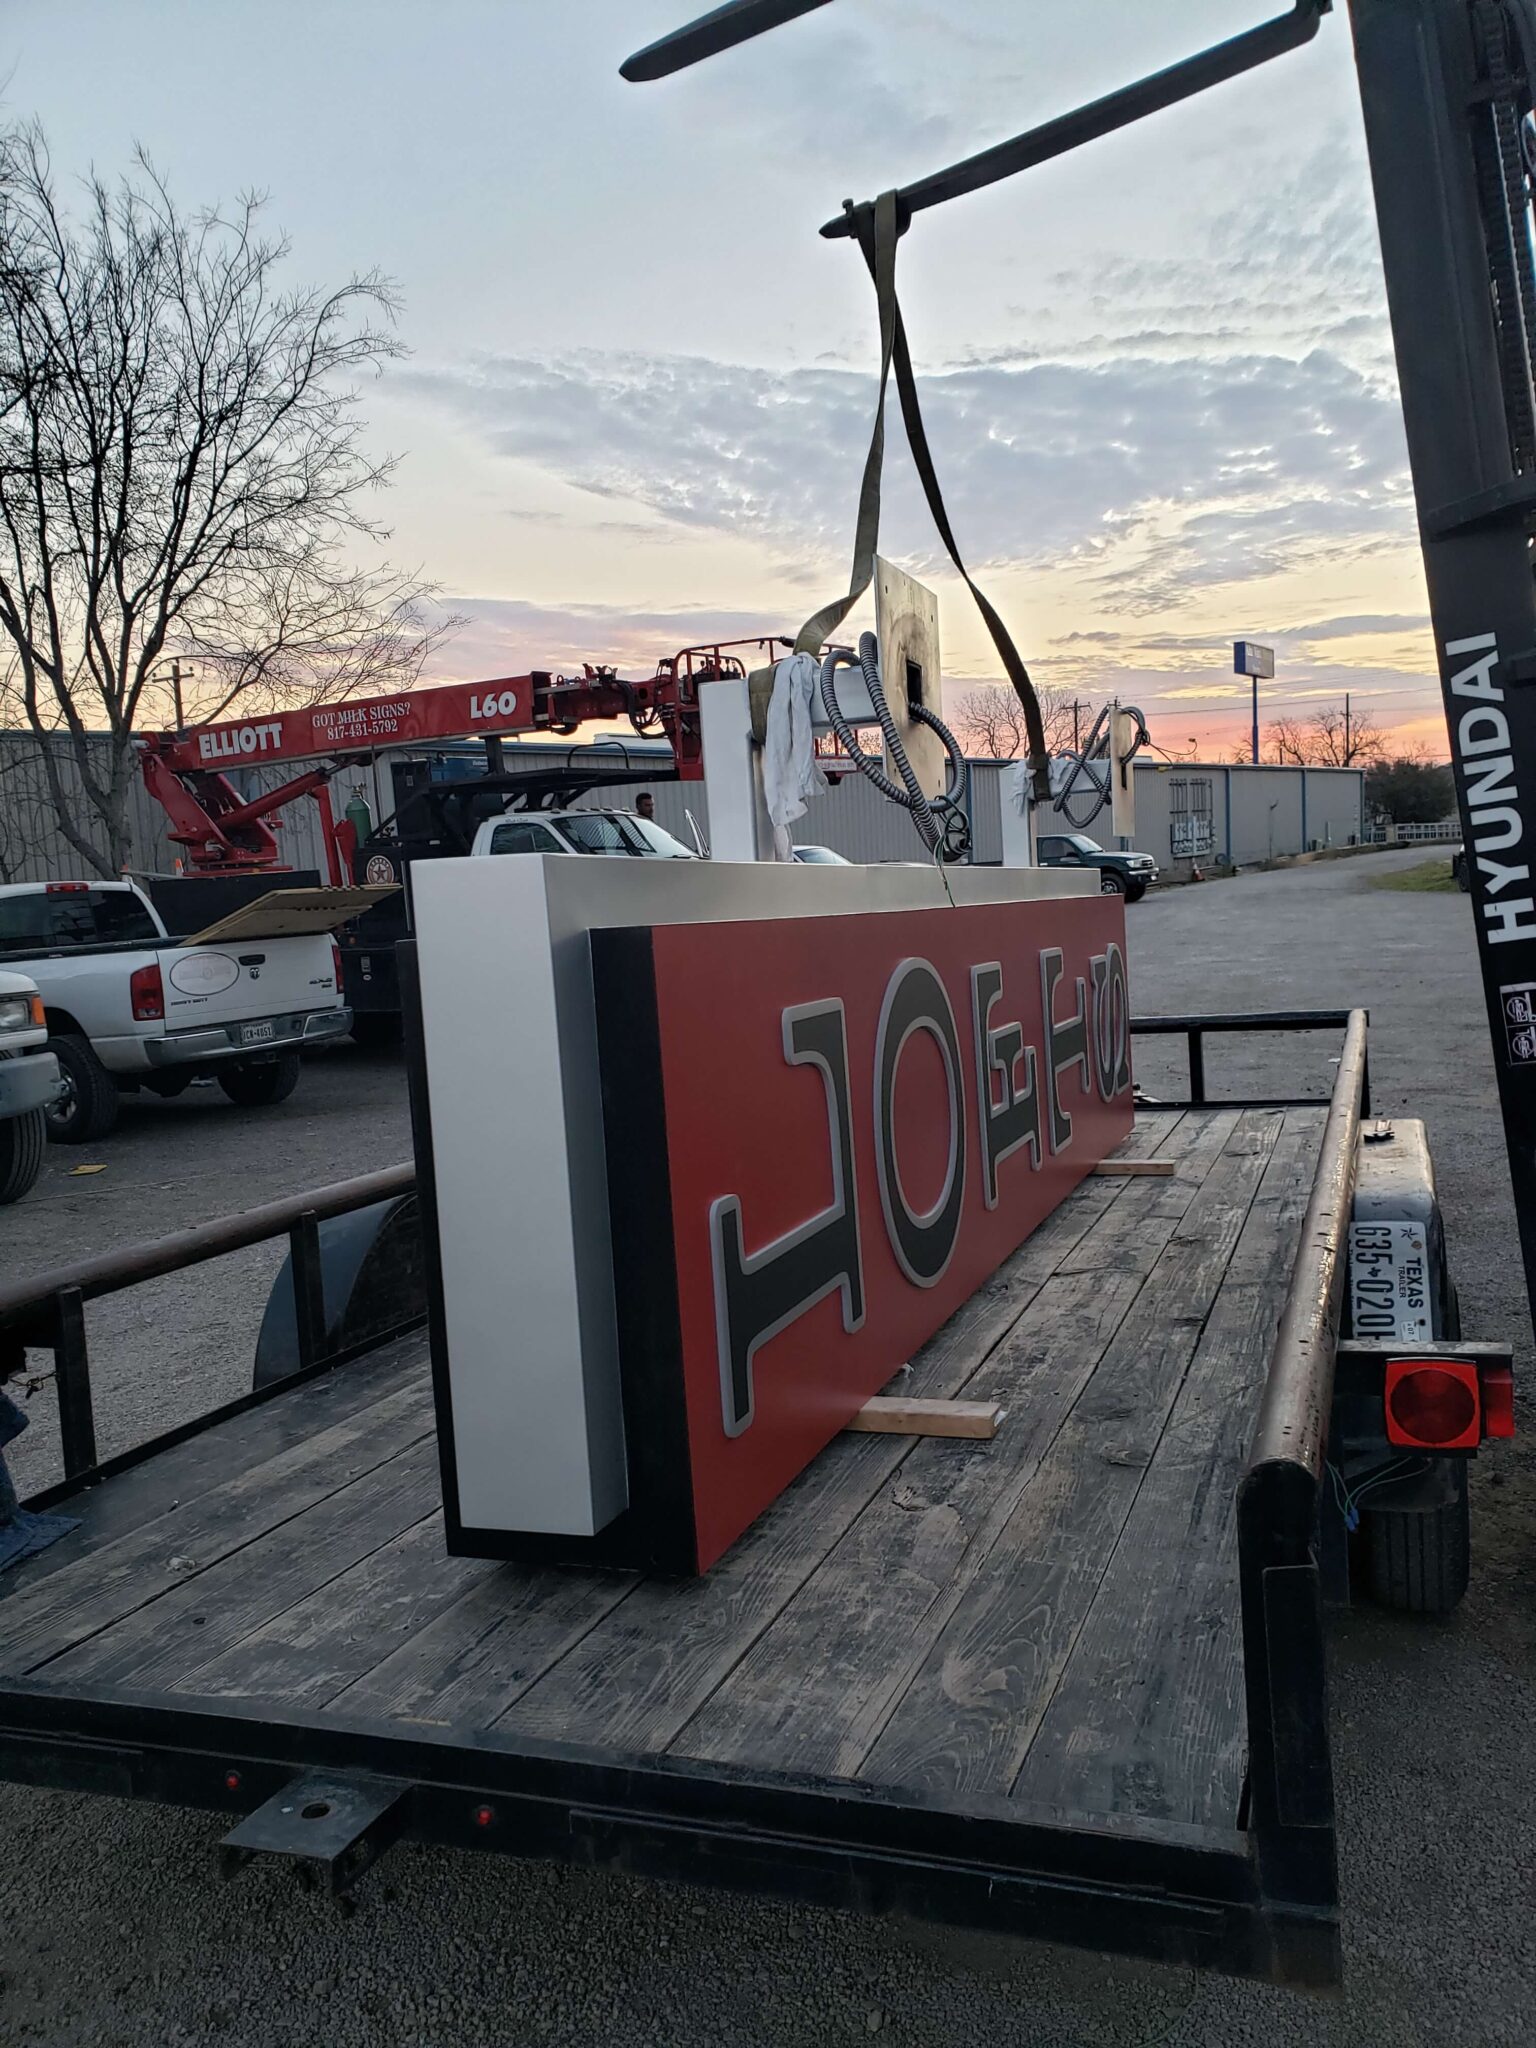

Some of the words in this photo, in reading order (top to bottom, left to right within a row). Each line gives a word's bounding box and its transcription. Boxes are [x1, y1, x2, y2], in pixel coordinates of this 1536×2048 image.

[312, 714, 336, 728] GOT
[337, 708, 367, 726] MILK
[369, 702, 411, 718] SIGNS?
[470, 691, 517, 719] L60
[198, 722, 283, 760] ELLIOTT
[327, 719, 398, 741] 817-431-5792
[1444, 631, 1536, 946] HYUNDAI
[1398, 1265, 1407, 1299] TRAILER
[1406, 1257, 1424, 1309] TEXAS
